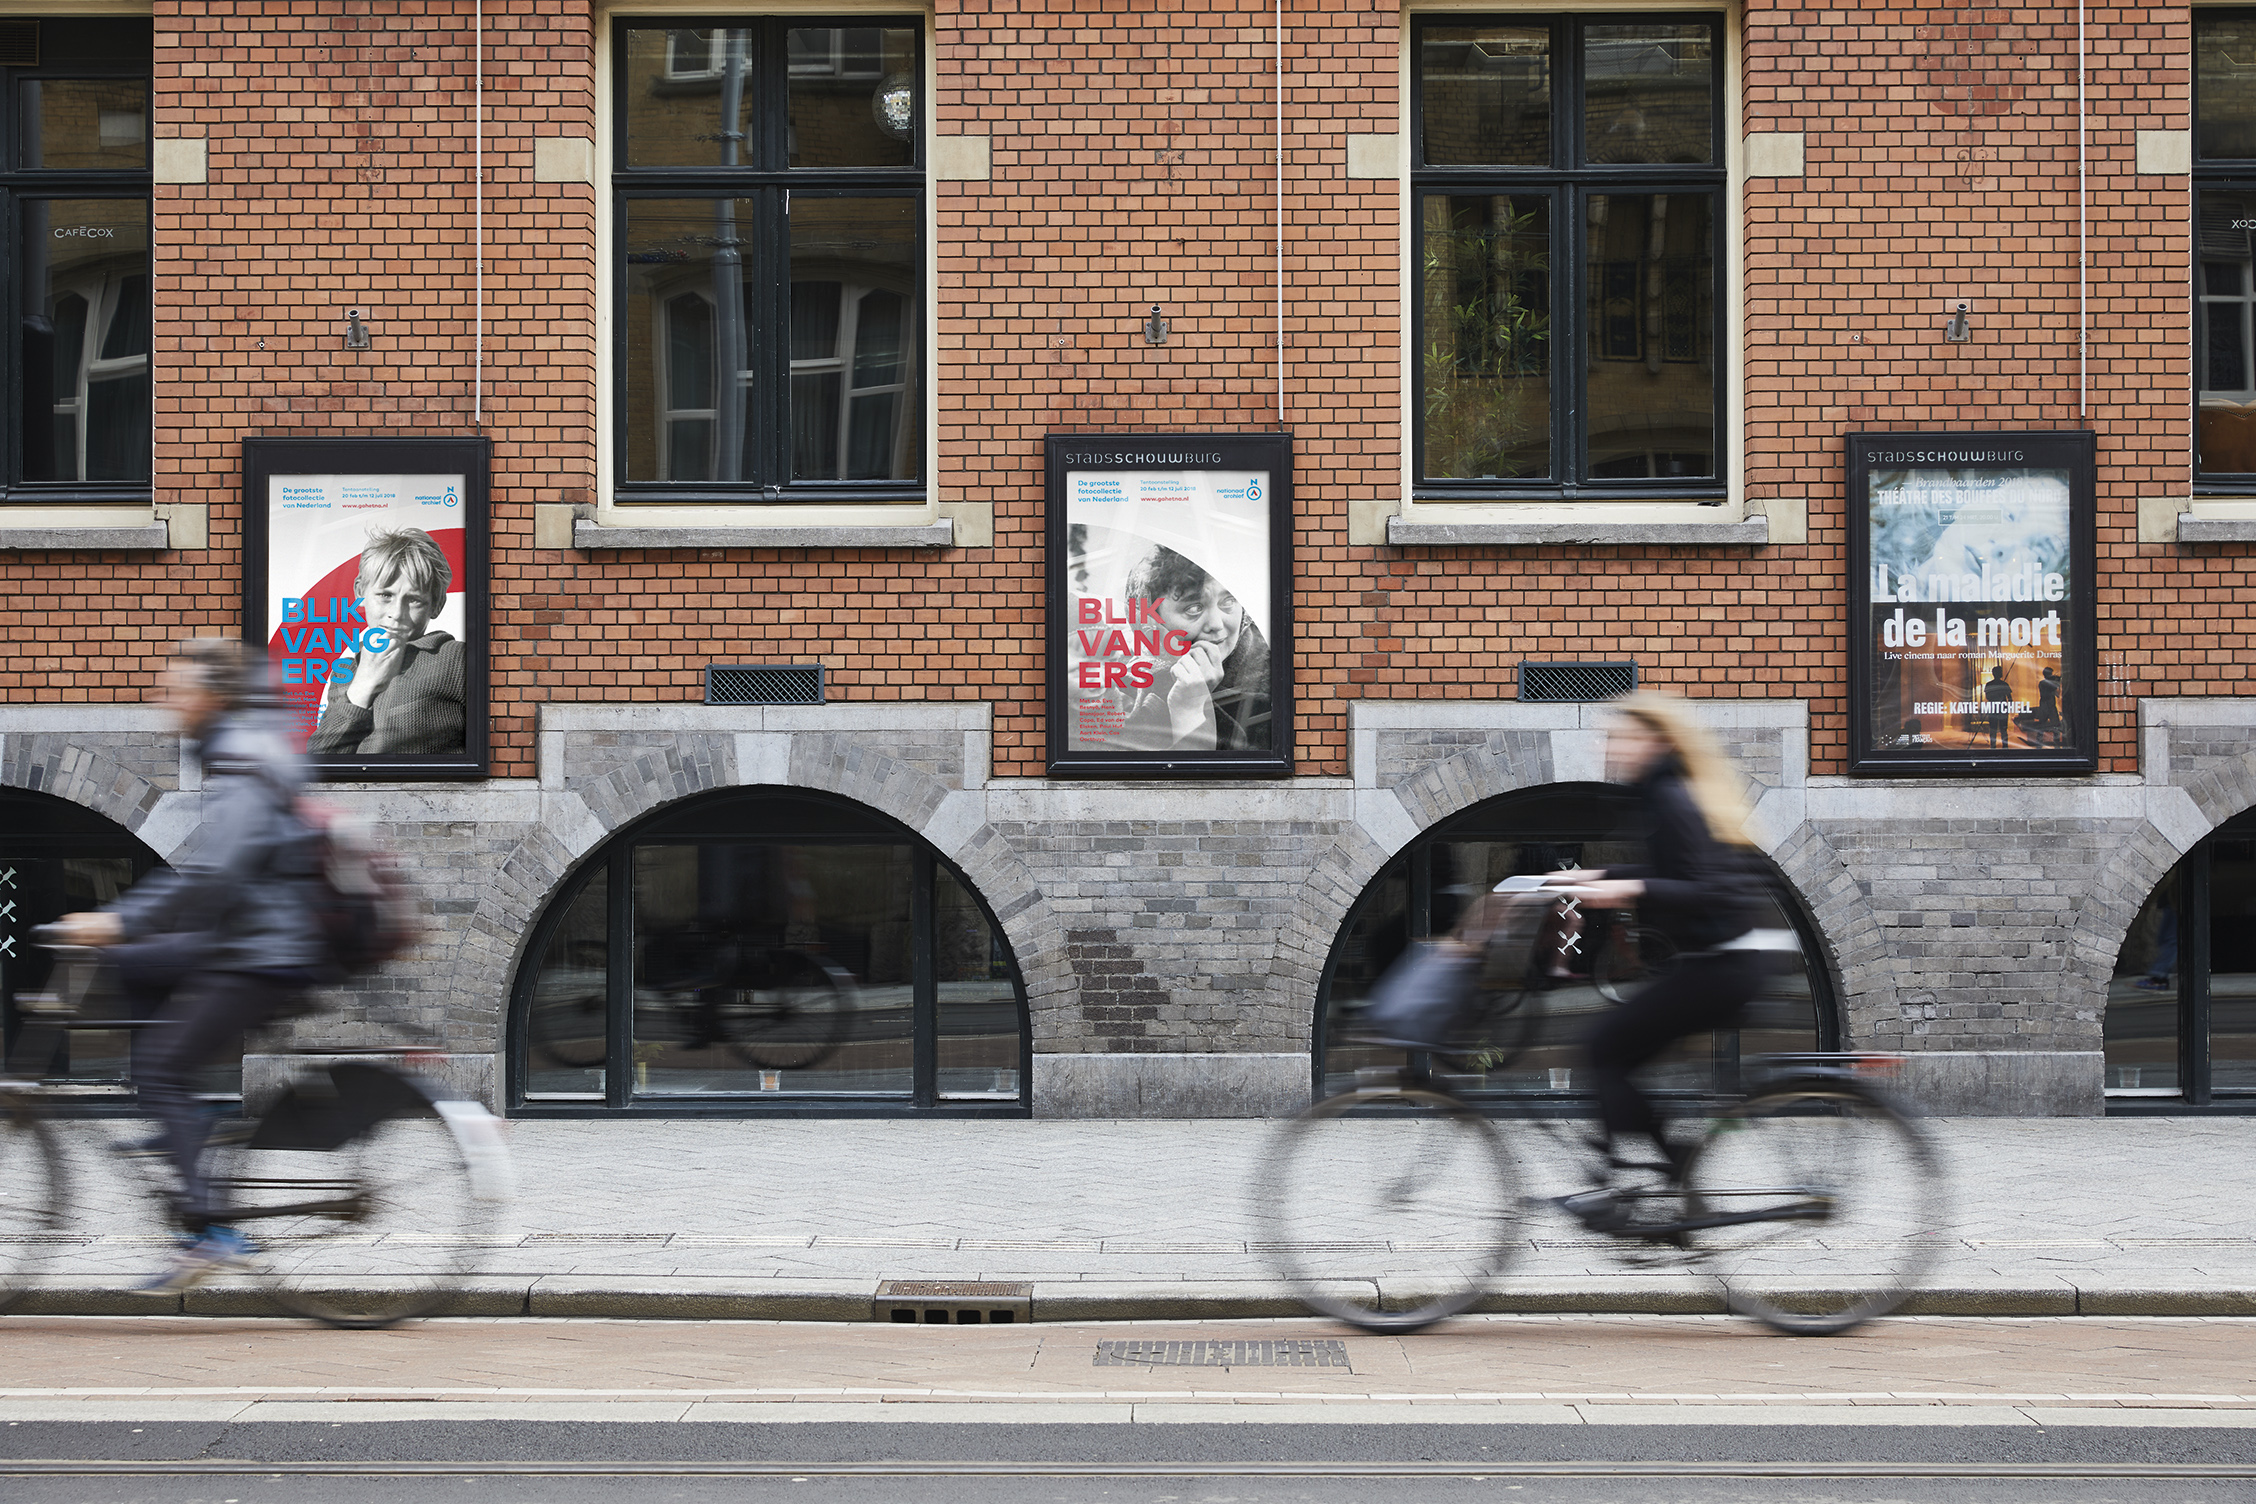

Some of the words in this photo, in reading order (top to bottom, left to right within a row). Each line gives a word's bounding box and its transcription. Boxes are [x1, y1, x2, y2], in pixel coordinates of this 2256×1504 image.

[1998, 476, 2024, 487] 2018
[1877, 486, 1928, 504] THÉÂTRE
[1931, 490, 1952, 504] DES
[1956, 489, 2006, 504] BOUFFES
[1878, 564, 1917, 603] La
[1928, 562, 2065, 602] maladie
[282, 598, 366, 623] BLIK
[1078, 598, 1166, 624] BLIK
[280, 627, 390, 654] VANG
[1884, 608, 1926, 648] de
[1936, 608, 1968, 647] la
[1978, 610, 2062, 647] mort
[1077, 629, 1192, 656] VANG
[1884, 651, 1902, 660] Live
[1904, 652, 1934, 660] cinema
[1988, 650, 2034, 660] Marguerite
[2036, 650, 2062, 659] Duras
[282, 658, 354, 684] ERS
[1078, 662, 1154, 688] ERS
[1914, 702, 1948, 715] REGIE:
[1950, 702, 1978, 714] KATIE
[1980, 701, 2032, 714] MITCHELL
